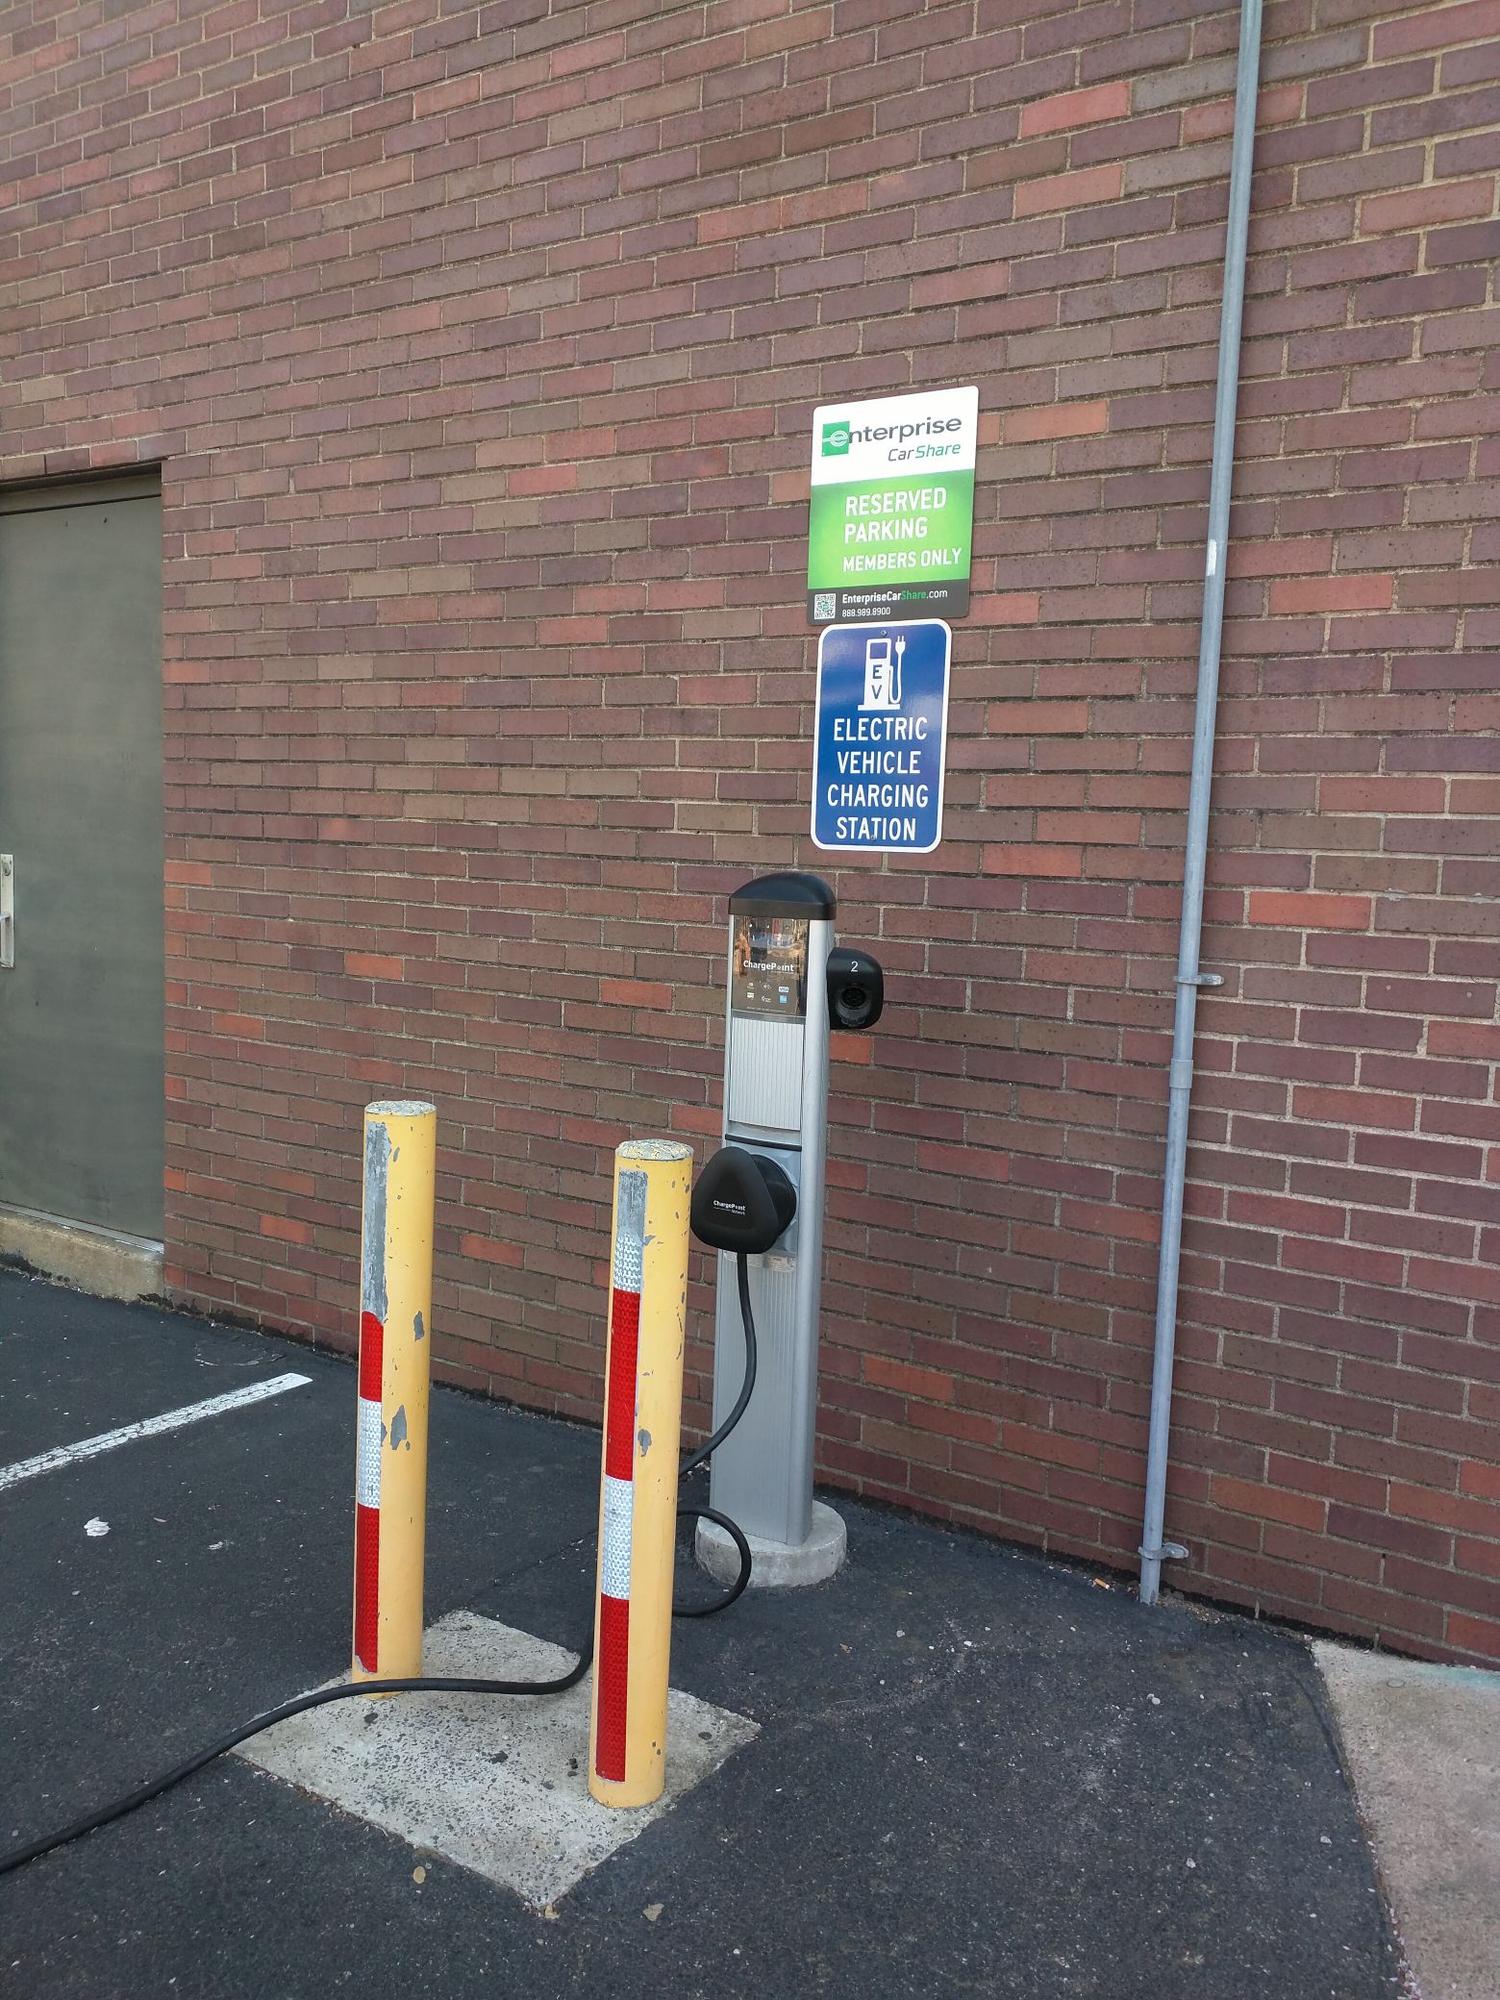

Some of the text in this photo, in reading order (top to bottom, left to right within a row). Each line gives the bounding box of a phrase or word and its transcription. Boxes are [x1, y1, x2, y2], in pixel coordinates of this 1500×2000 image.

[829, 417, 963, 448] enterprise
[888, 443, 961, 462] CarShare
[845, 486, 947, 517] RESERVED
[844, 517, 928, 544] PARKING
[842, 547, 962, 573] MEMBERS ONLY
[842, 589, 948, 605] EnterpriseCarShare.com
[841, 606, 891, 618] 888.989.8900
[833, 717, 928, 741] ELECTRIC
[837, 750, 921, 774] VEHICLE
[827, 783, 929, 808] CHARGING
[836, 816, 917, 841] STATION
[743, 959, 795, 972] ChargePoint
[850, 960, 859, 973] 2
